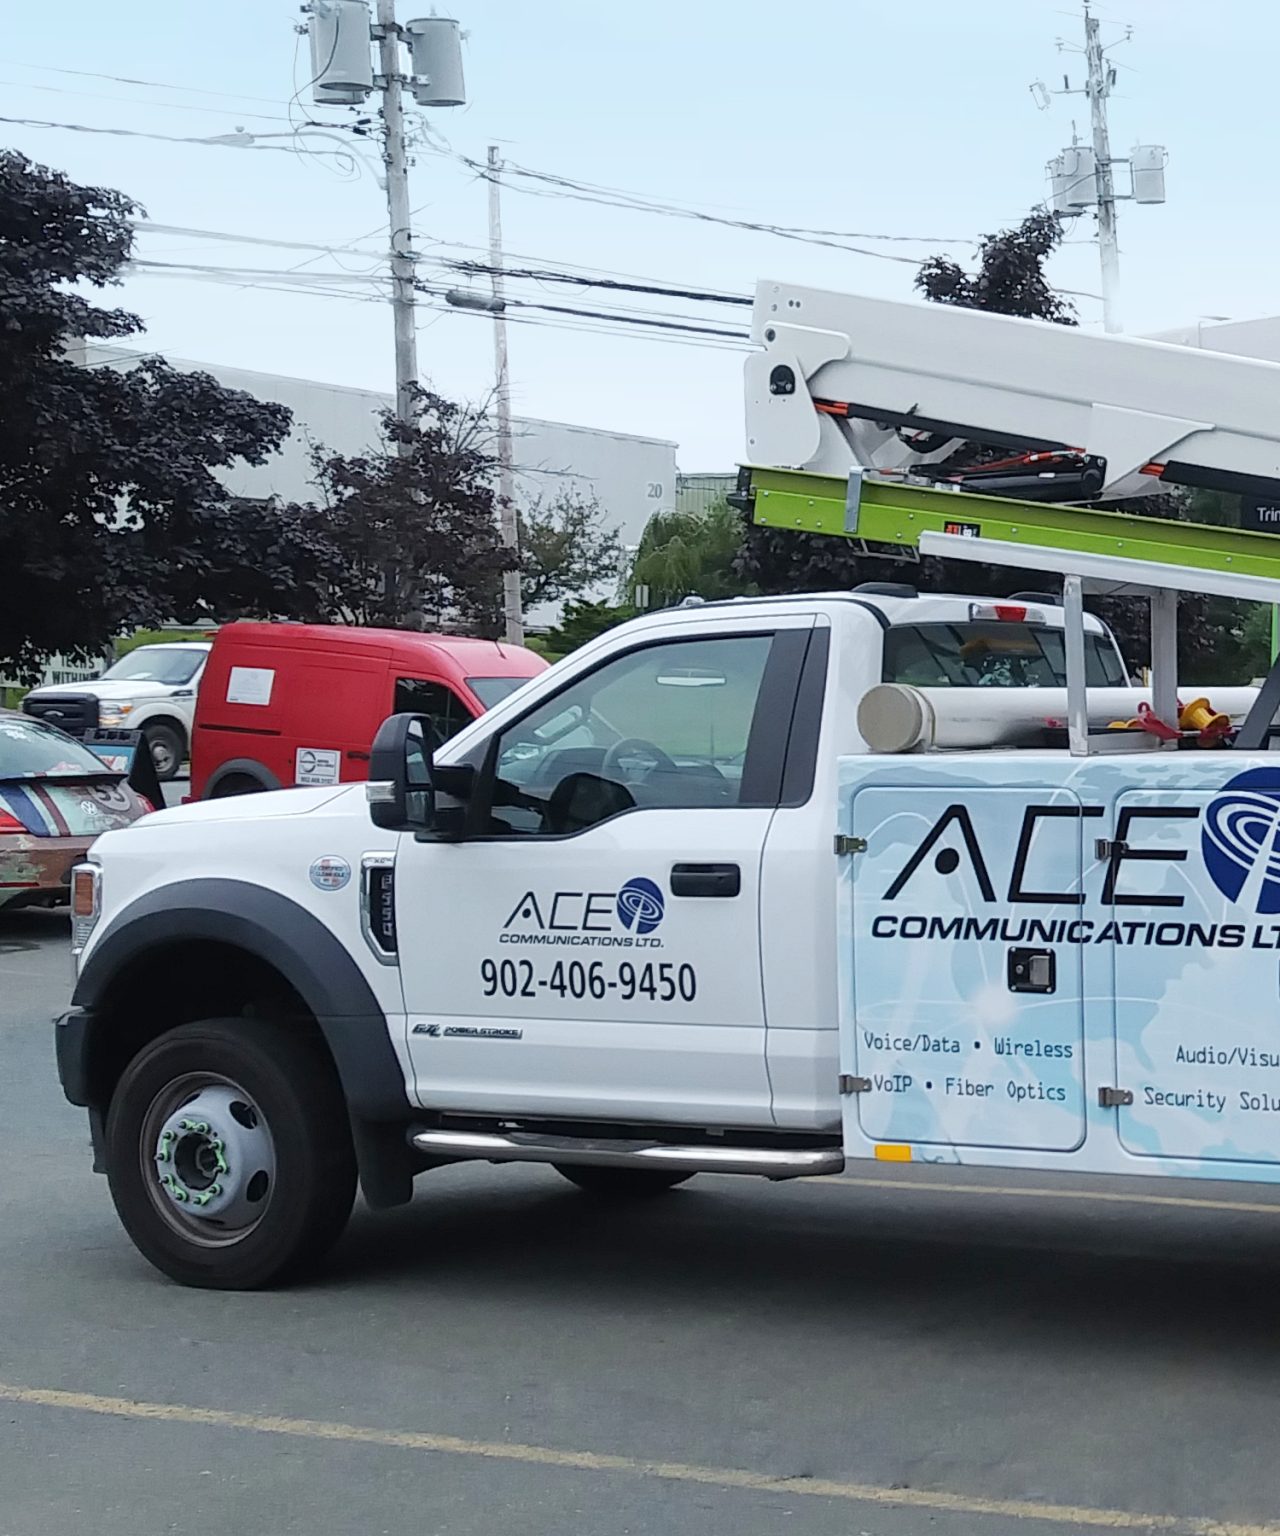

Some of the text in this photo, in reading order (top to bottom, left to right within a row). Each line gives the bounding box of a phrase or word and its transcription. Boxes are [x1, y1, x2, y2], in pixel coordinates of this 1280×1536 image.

[647, 482, 663, 499] 20
[882, 804, 1200, 907] ACE
[503, 891, 617, 931] ACE
[499, 933, 665, 948] COMMUNICATIONS LTD.
[871, 915, 1246, 949] COMMUNICATIONS
[481, 957, 697, 1002] 902-406-9450
[444, 1026, 479, 1036] POWER
[479, 1028, 520, 1038] STROKE
[863, 1031, 1074, 1059] Voice/Data Wireless
[874, 1074, 1067, 1102] VoIP Fiber Optics
[1143, 1086, 1227, 1113] Security
